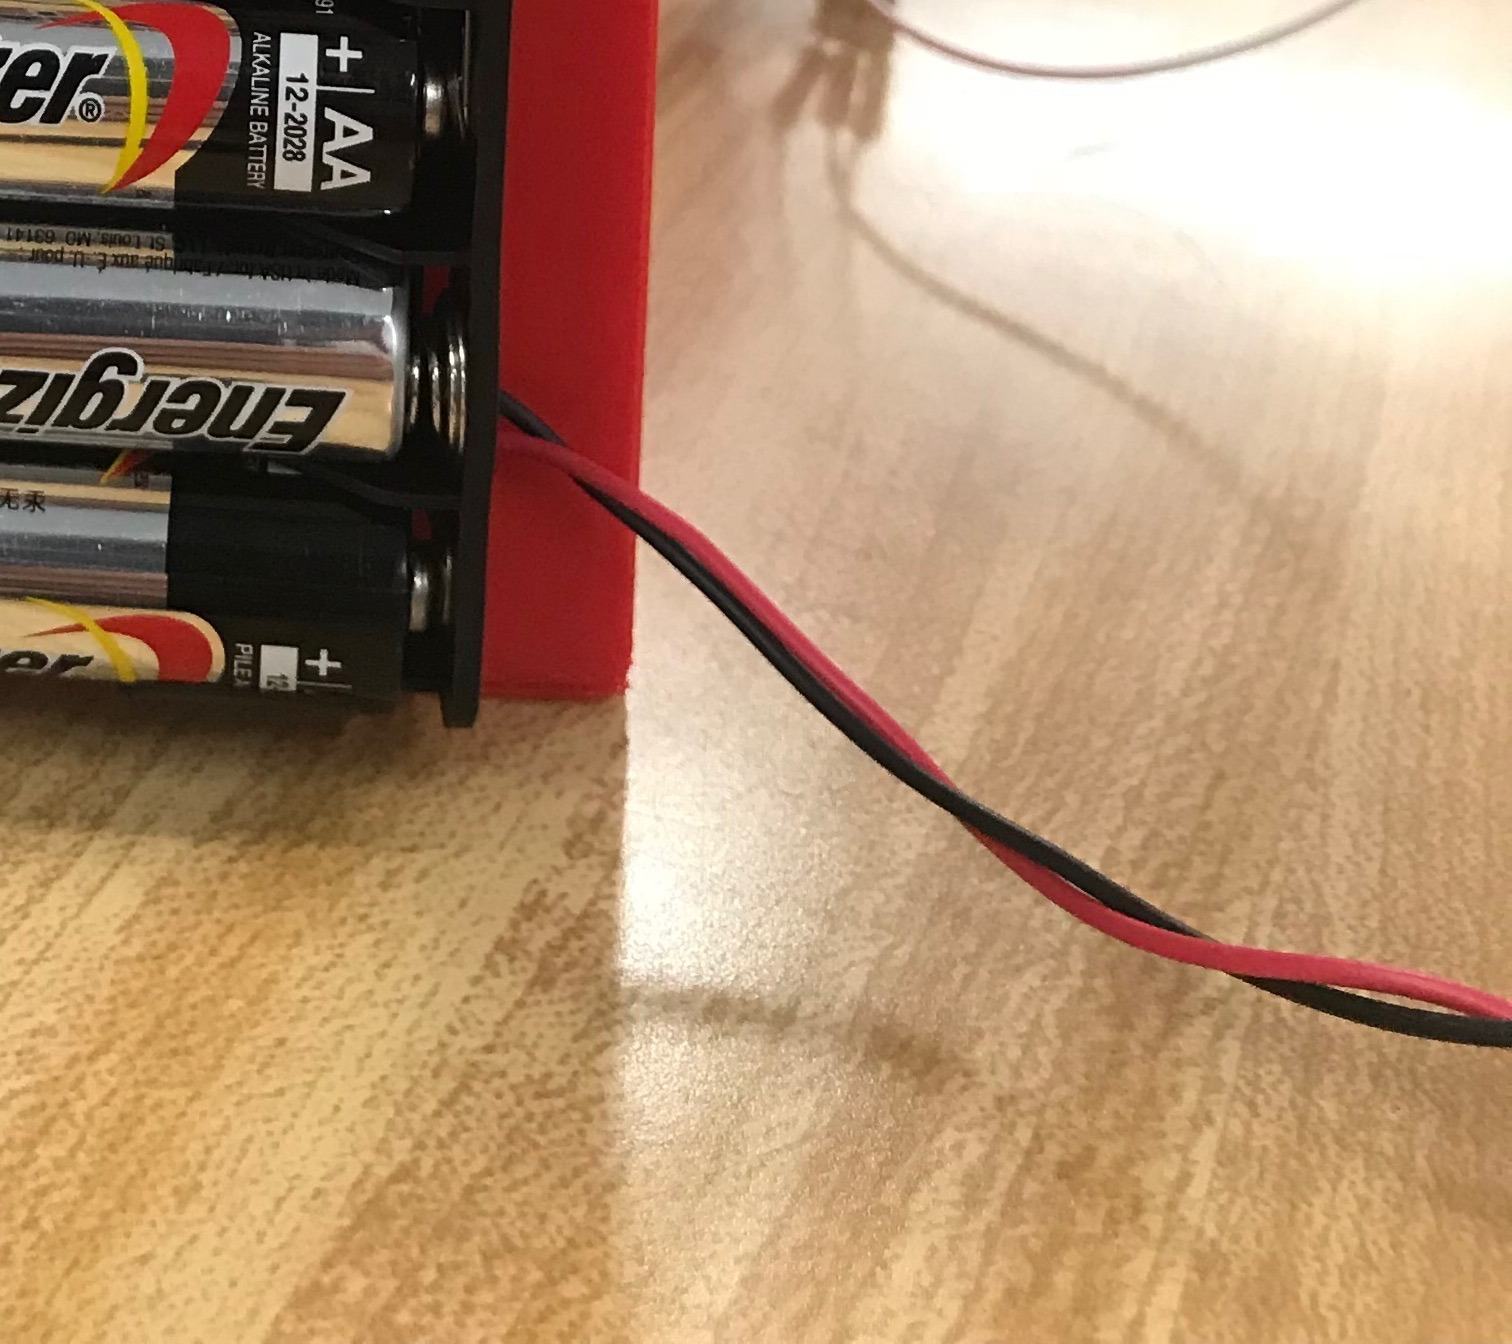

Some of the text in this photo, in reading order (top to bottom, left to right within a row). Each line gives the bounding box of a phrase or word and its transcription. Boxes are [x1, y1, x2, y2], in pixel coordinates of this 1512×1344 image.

[246, 30, 273, 190] ALKALINE BATTERY
[281, 72, 311, 163] 12-2028
[320, 105, 374, 191] AA
[6, 226, 56, 244] 63141
[30, 245, 65, 264] pour
